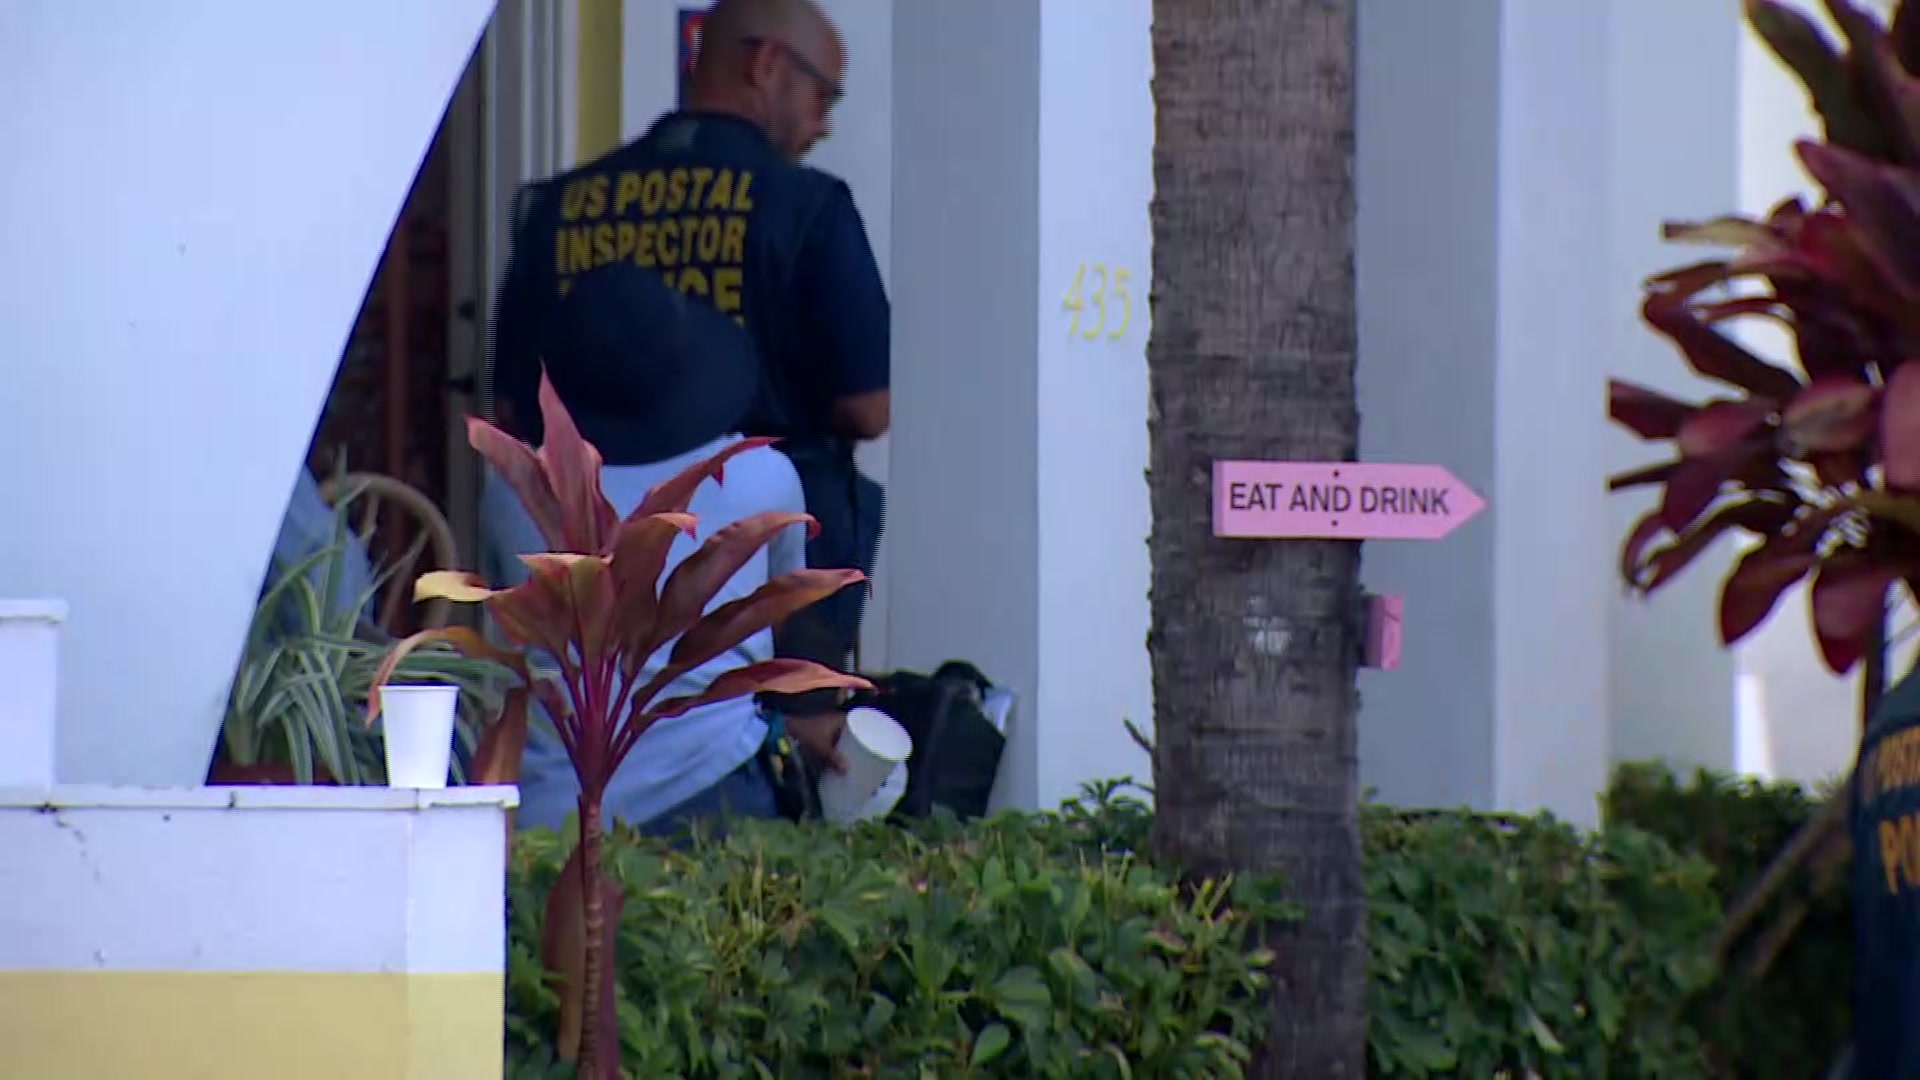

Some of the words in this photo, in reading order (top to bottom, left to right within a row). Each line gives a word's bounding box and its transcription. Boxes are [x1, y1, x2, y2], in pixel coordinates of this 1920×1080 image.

[560, 174, 610, 221] US
[613, 167, 754, 216] POSTAL
[555, 214, 747, 275] INSPECTOR
[1062, 262, 1132, 340] 435
[1229, 482, 1283, 511] EAT
[1289, 484, 1351, 513] AND
[1360, 486, 1450, 516] DRINK
